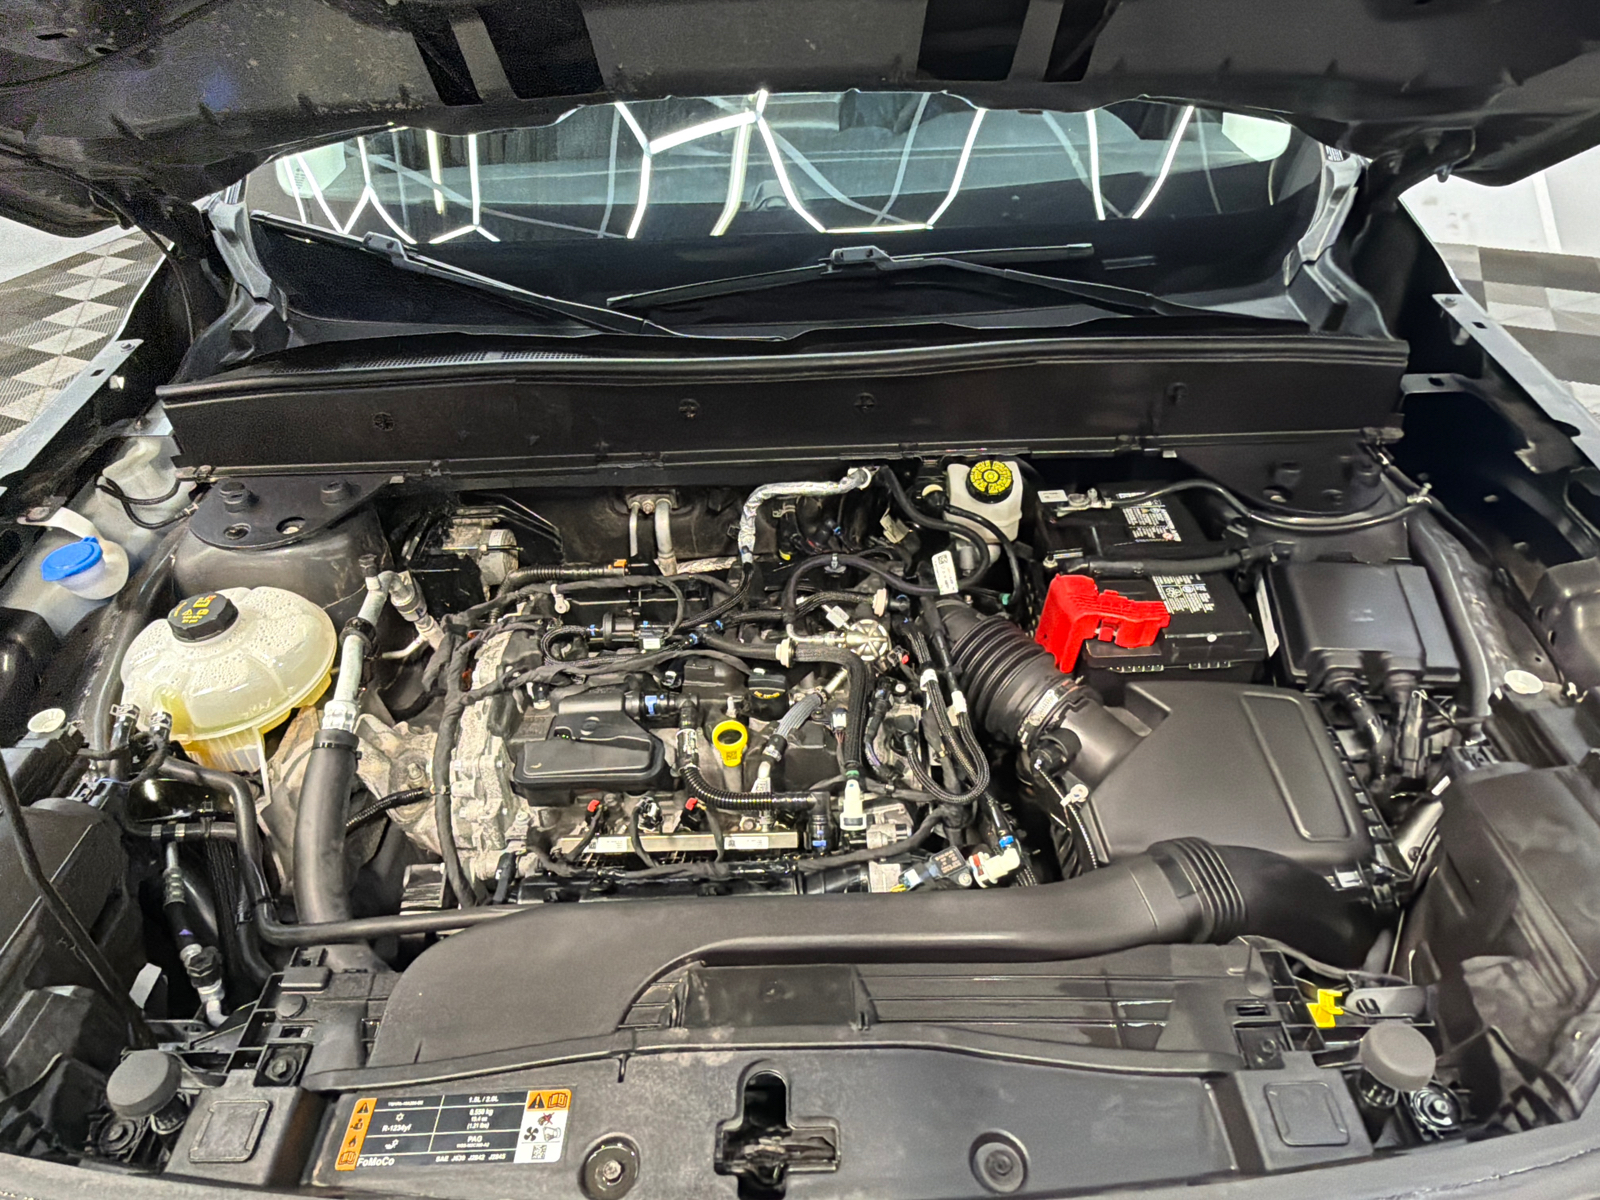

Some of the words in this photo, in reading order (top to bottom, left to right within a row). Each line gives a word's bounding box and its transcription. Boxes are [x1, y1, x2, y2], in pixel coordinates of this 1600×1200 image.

[486, 1108, 494, 1117] kg
[381, 1123, 413, 1133] R-1234yf
[467, 1135, 483, 1143] PAO
[356, 1156, 396, 1168] FoMoCo
